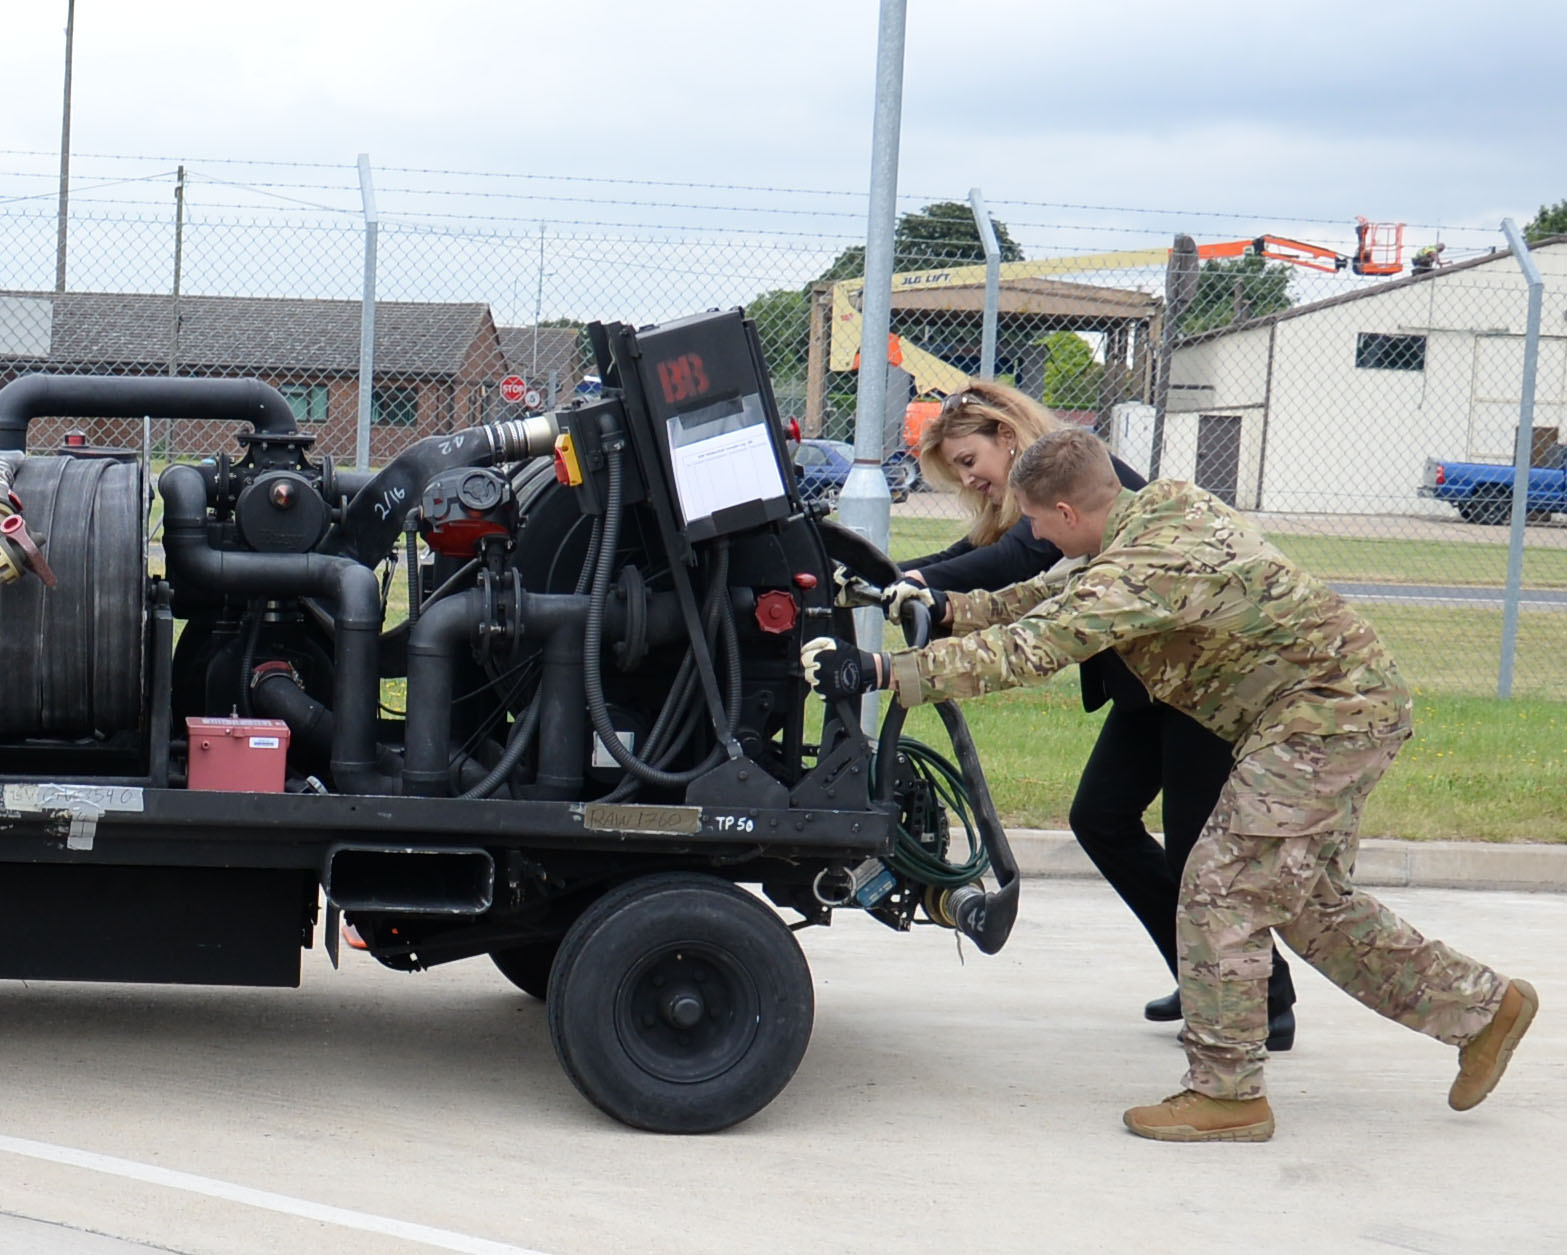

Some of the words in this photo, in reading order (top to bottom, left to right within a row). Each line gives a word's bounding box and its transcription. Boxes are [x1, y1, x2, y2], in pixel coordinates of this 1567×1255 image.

[901, 275, 921, 286] JLG
[925, 273, 951, 284] LIFT
[502, 384, 525, 395] STOP
[374, 487, 406, 521] 2/16
